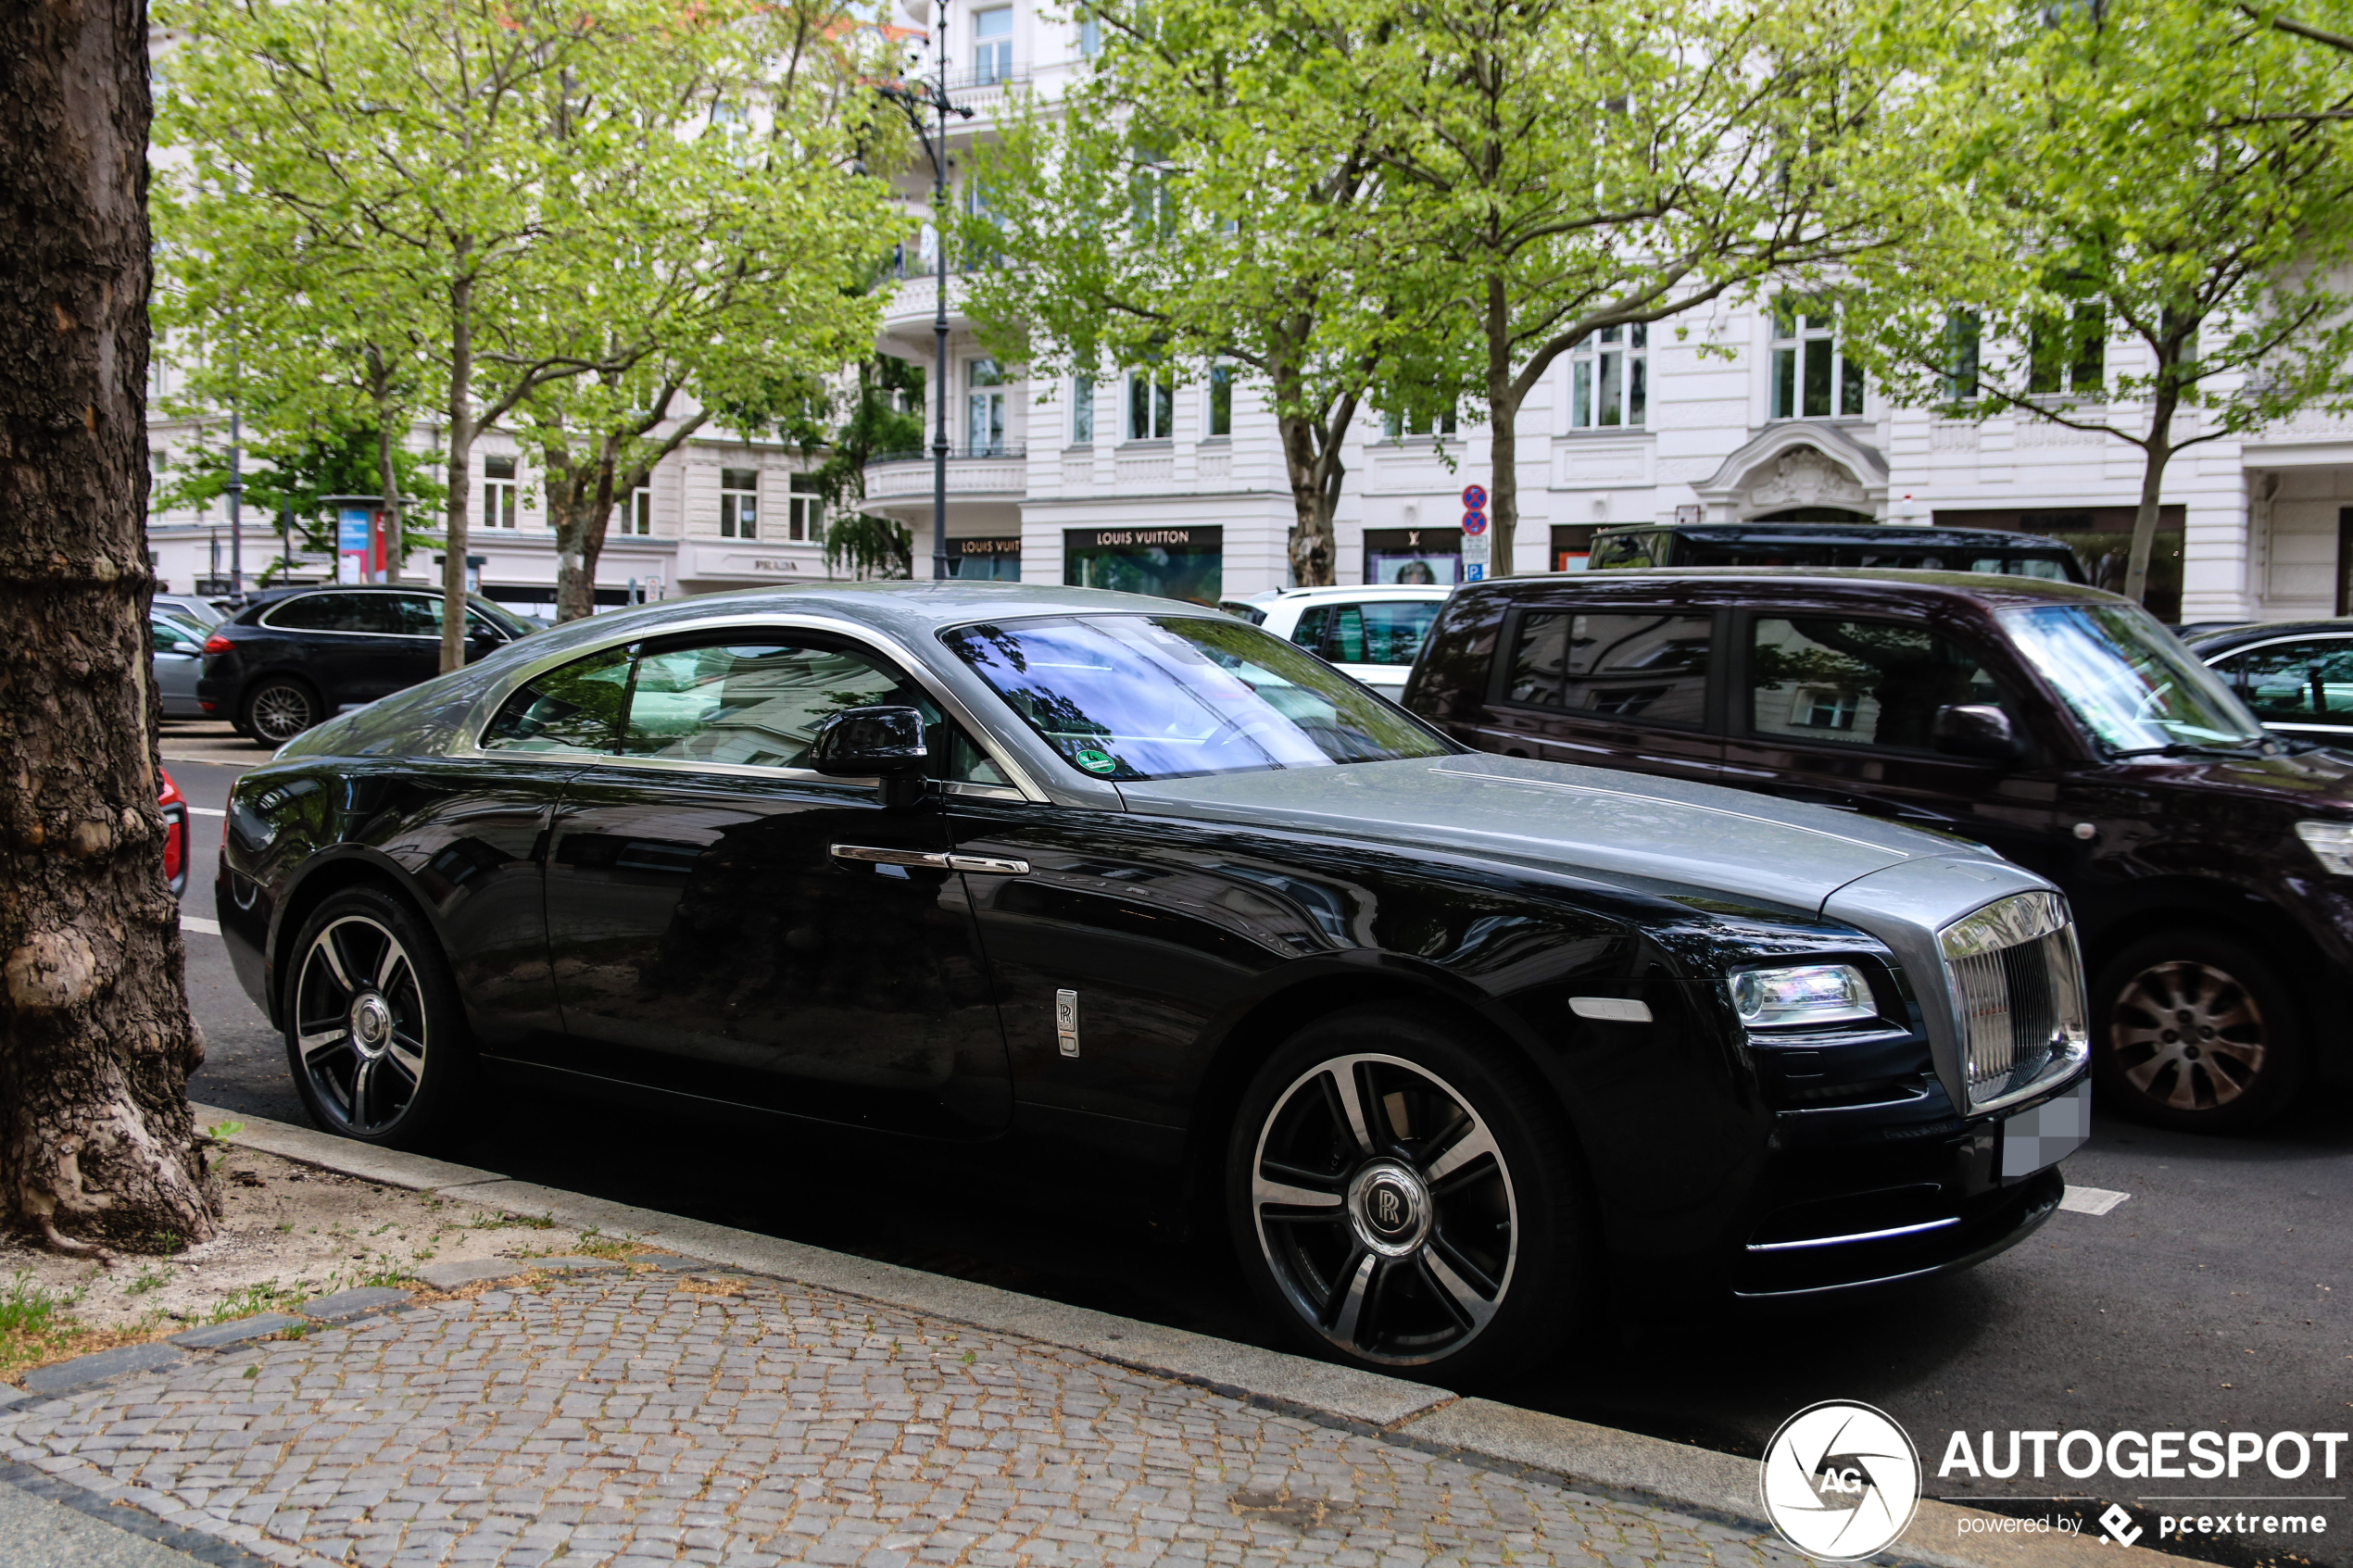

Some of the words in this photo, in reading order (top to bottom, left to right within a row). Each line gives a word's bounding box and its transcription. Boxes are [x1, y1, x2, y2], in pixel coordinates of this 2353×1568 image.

[1097, 532, 1132, 546] LOUIS
[1136, 530, 1189, 545] VUITTON
[962, 541, 994, 554] LOUIS
[995, 540, 1021, 553] VUIT
